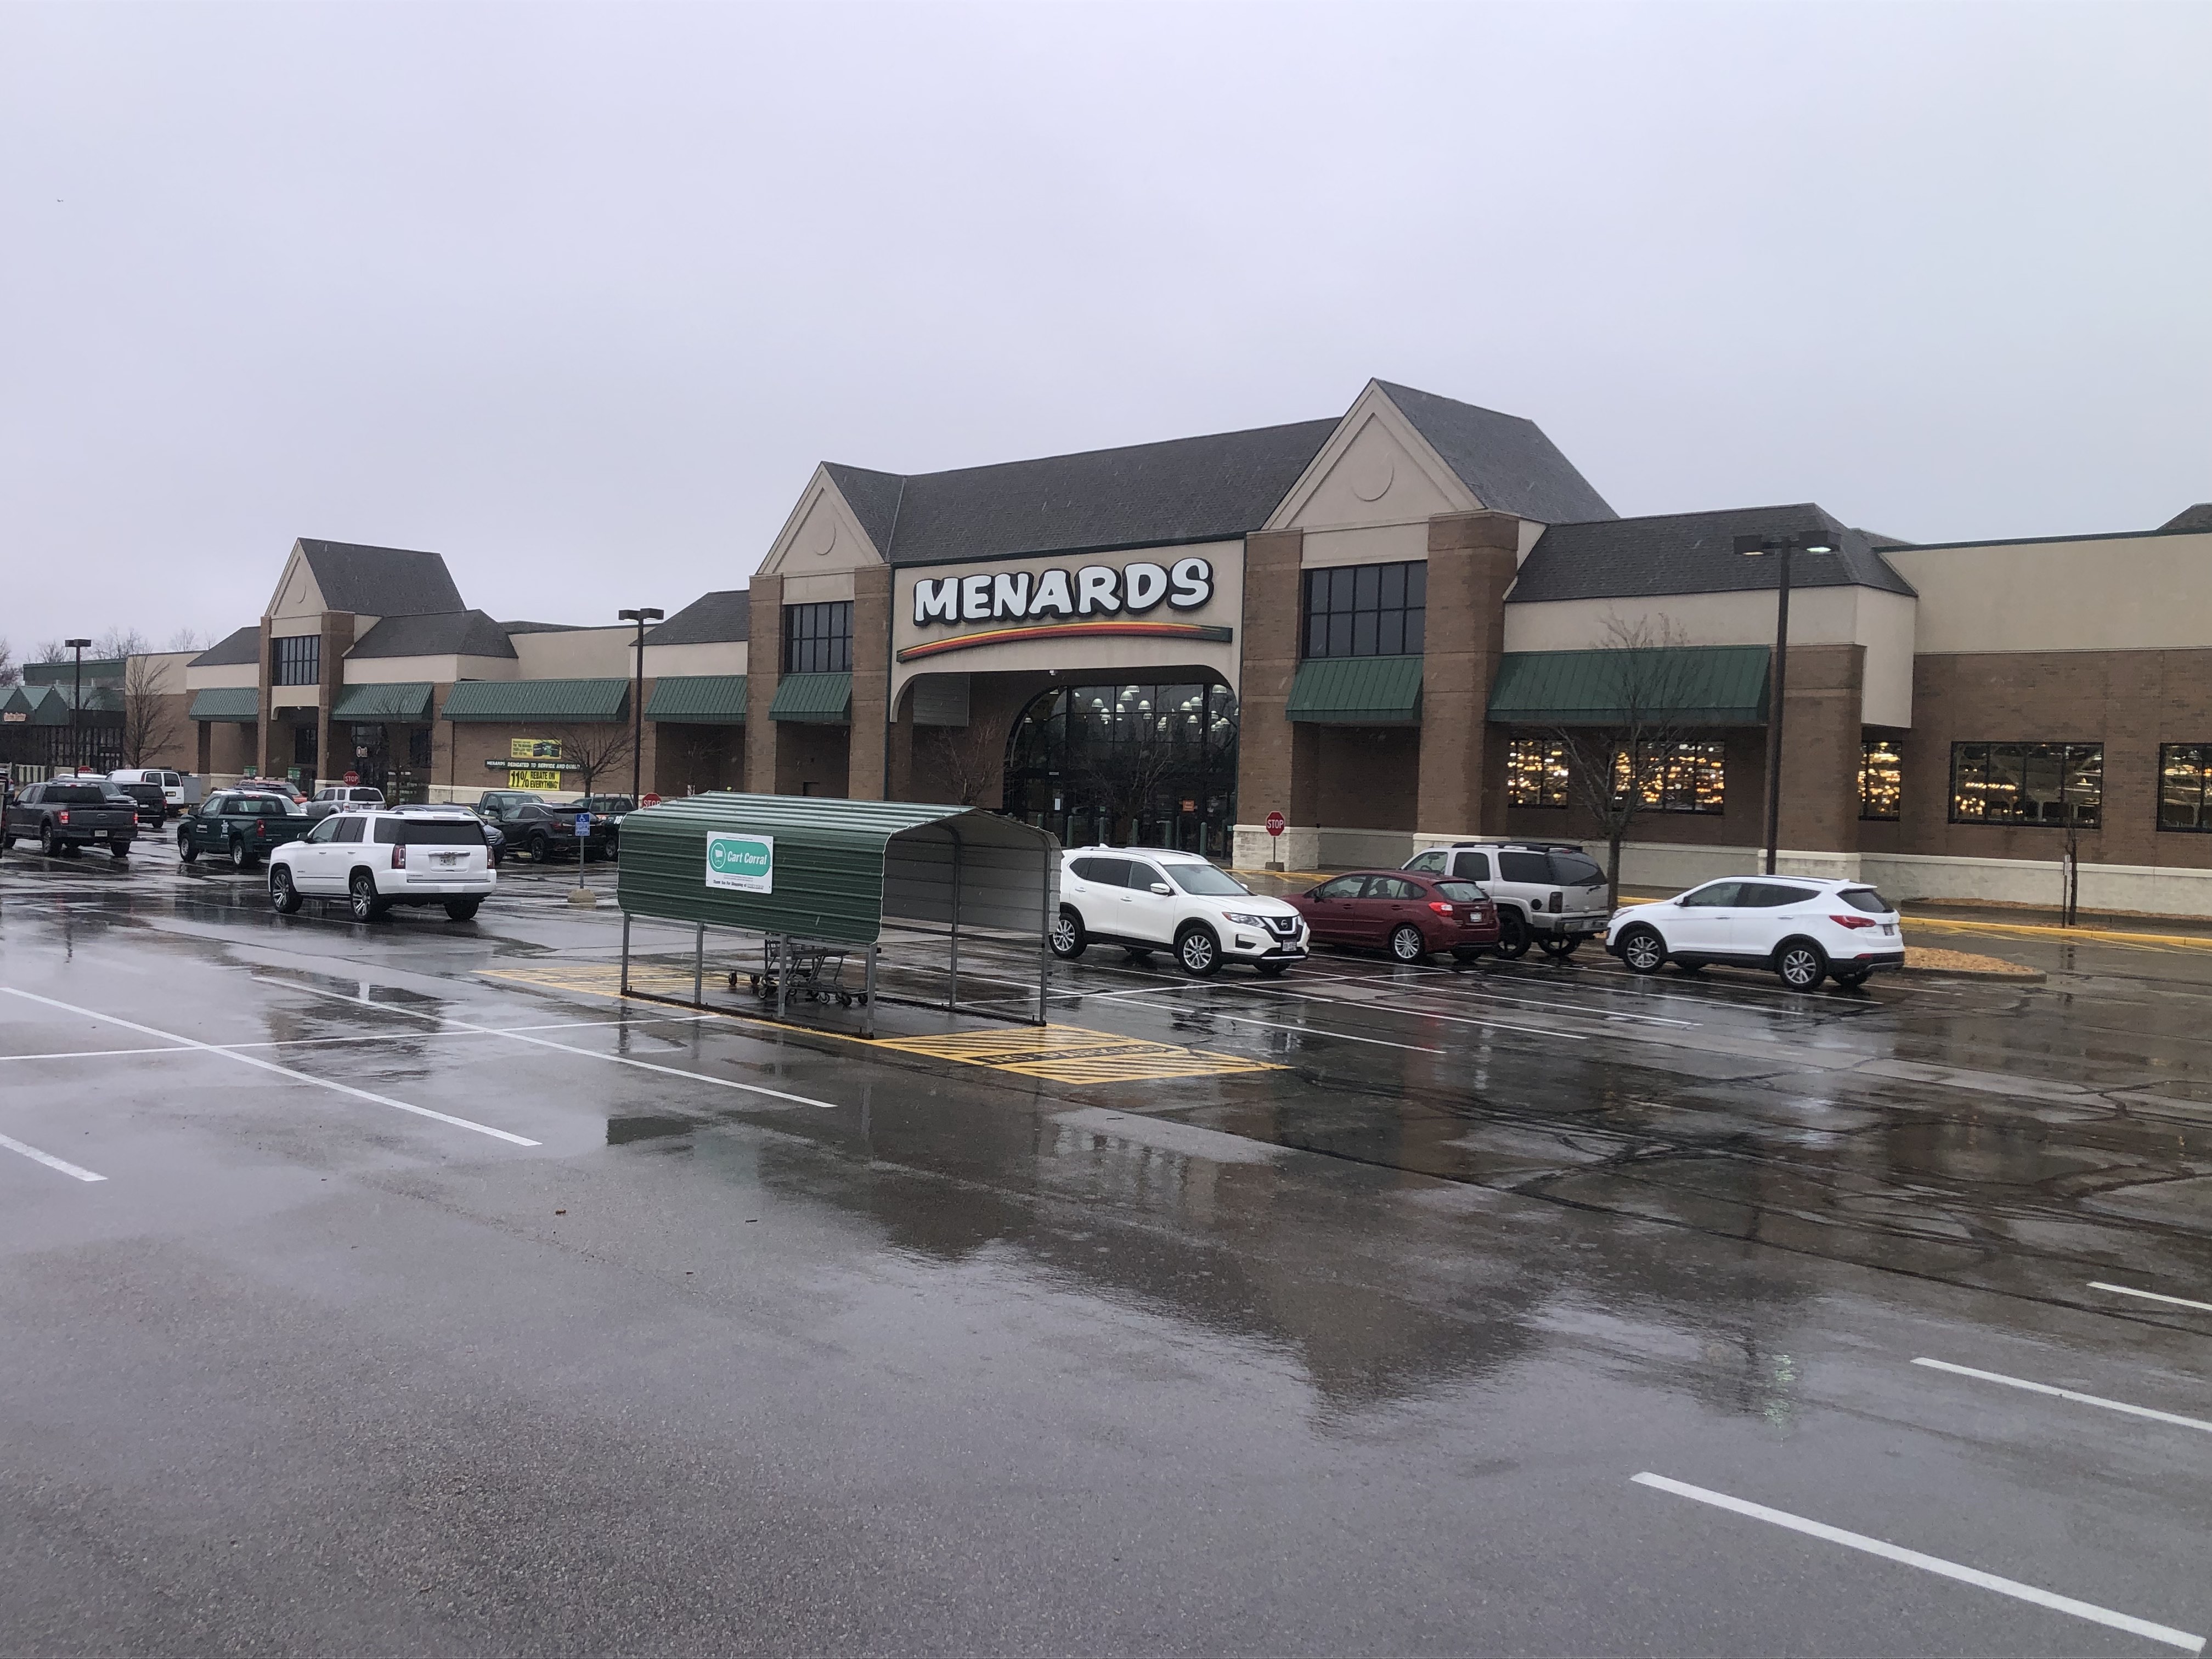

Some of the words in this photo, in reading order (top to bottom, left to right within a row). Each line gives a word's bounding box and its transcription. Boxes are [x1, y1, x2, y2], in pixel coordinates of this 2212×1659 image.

[913, 557, 1214, 627] MENARDS
[357, 746, 368, 757] Out
[511, 771, 529, 788] 11%
[531, 771, 548, 780] REBATE
[1267, 819, 1284, 828] STOP
[727, 851, 743, 863] Cart
[744, 853, 768, 865] Corral
